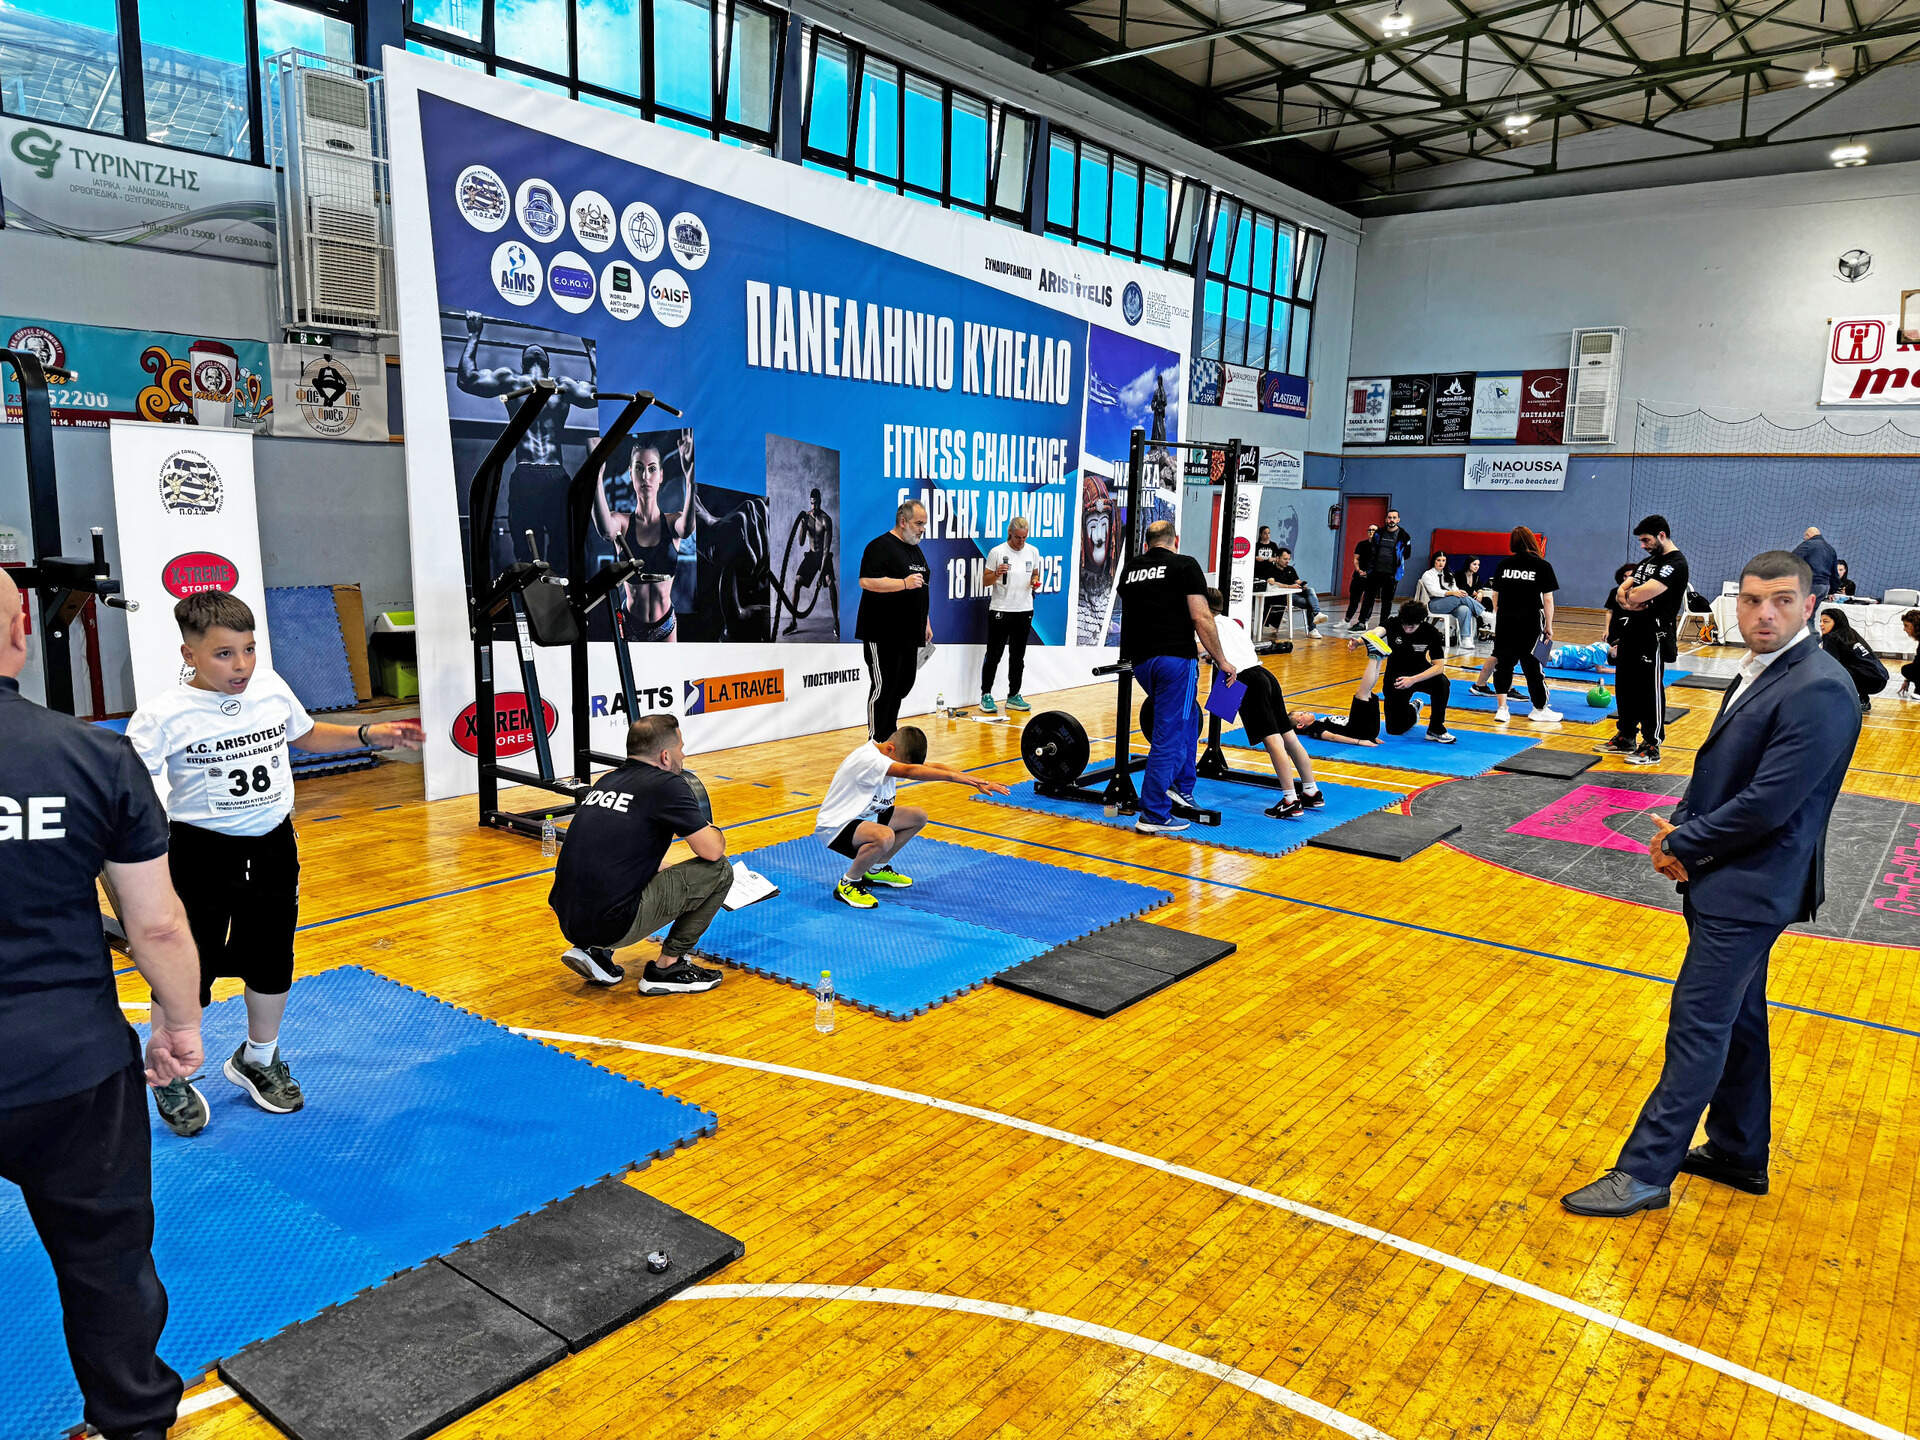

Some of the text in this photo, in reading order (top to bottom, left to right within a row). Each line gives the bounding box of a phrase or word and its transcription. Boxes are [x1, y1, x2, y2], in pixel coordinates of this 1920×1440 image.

[69, 147, 200, 192] ΤΥΡΙΝΤΖΗΣ
[92, 178, 121, 191] ΙΑΤΡΙΚΑ
[985, 257, 1032, 281] ΣΥΝΔΙΟΡΓΑΝΩΣΗ
[610, 293, 627, 301] WORLD
[651, 285, 689, 304] GAISF
[610, 300, 640, 310] ANTI-DOPING
[610, 307, 630, 315] AGENCY
[746, 279, 1071, 406] ΠΑΝΕΛΛΗΝΙΟ ΚΥΠΕΛΛΟ
[883, 423, 1068, 485] FITNESS CHALLENGE
[1492, 461, 1562, 471] NAOUSSA
[920, 488, 980, 540] ΑΡΣΗΣ
[171, 565, 230, 585] X-TREME
[947, 558, 966, 600] 18
[1036, 555, 1063, 593] 025
[1125, 565, 1167, 585] JUDGE
[1501, 569, 1536, 581] JUDGE
[803, 668, 860, 688] ΥΠΟΣΤΗΡΙΚΤΕΣ
[186, 723, 286, 754] A.C. ARISTOTELIS
[186, 756, 224, 765] FITNESS
[226, 744, 273, 762] CHALLENGE
[227, 765, 271, 797] 38
